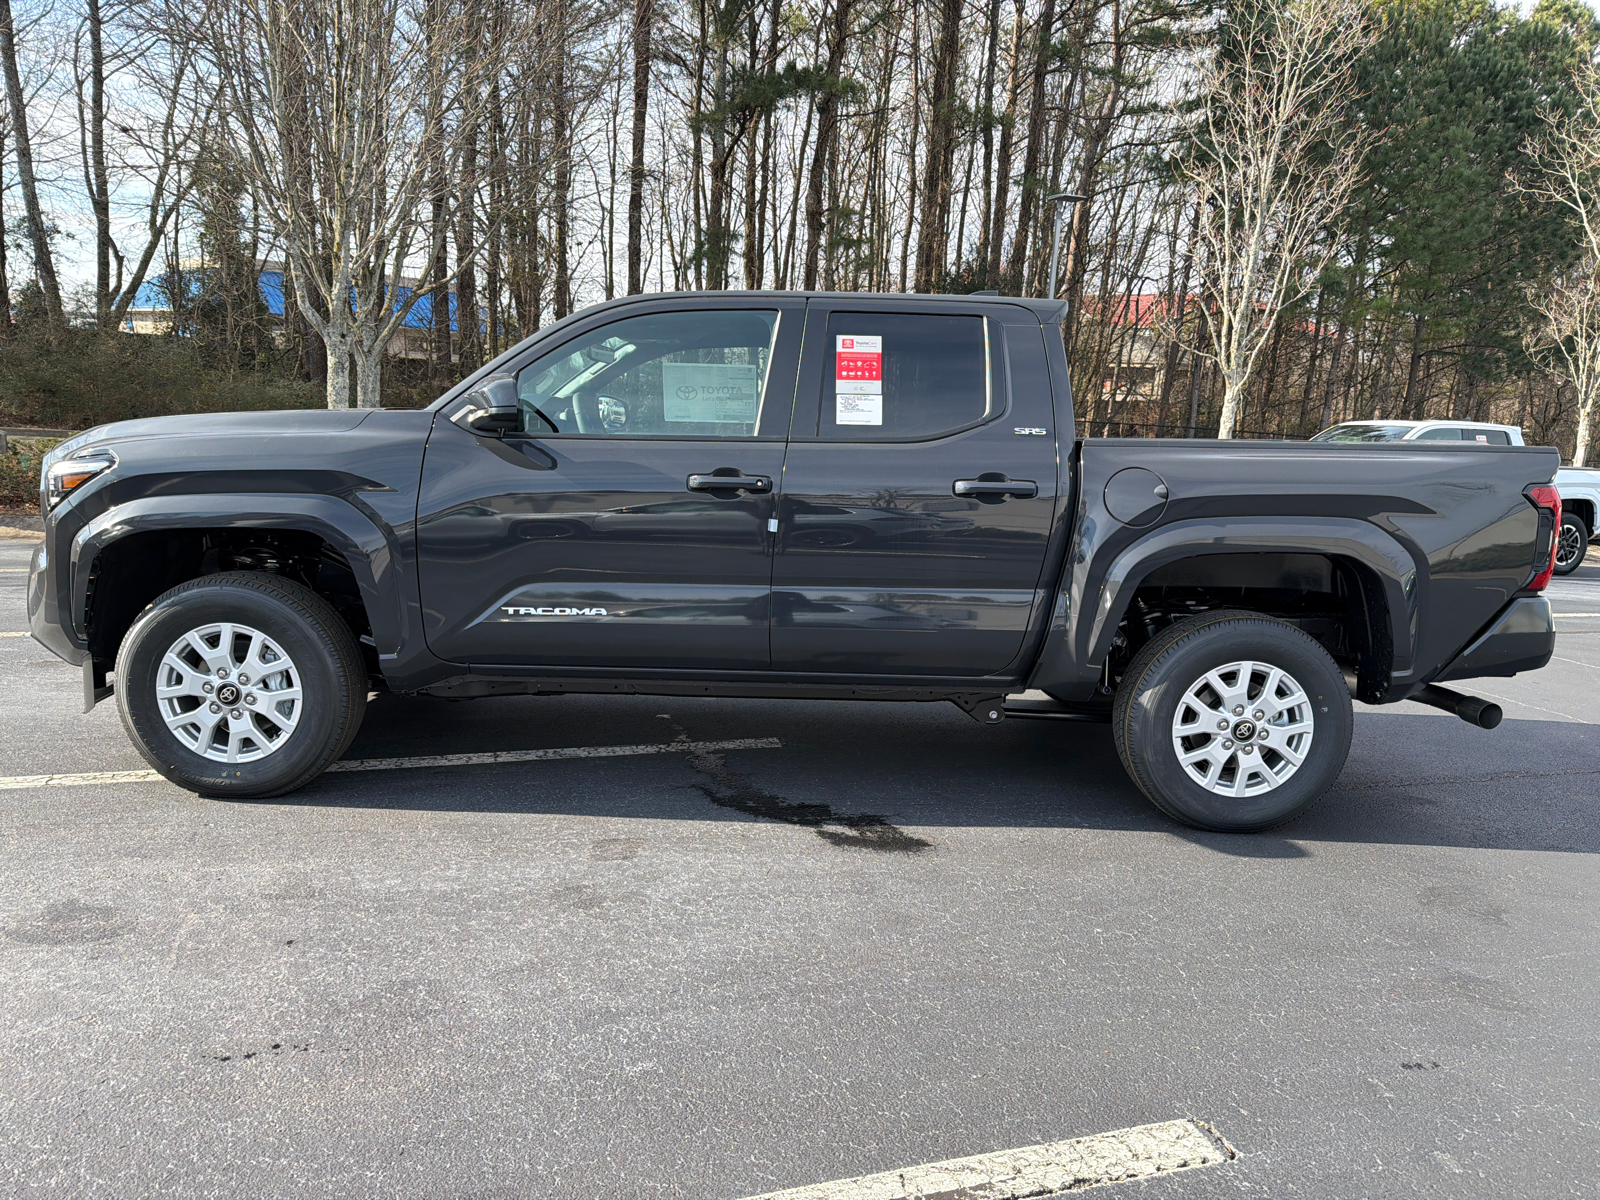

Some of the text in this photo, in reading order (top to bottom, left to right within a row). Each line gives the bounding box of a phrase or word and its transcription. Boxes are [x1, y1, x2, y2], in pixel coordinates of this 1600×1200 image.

[700, 386, 743, 395] TOYOTA
[1014, 427, 1047, 435] SR5
[500, 606, 608, 616] TACOMA
